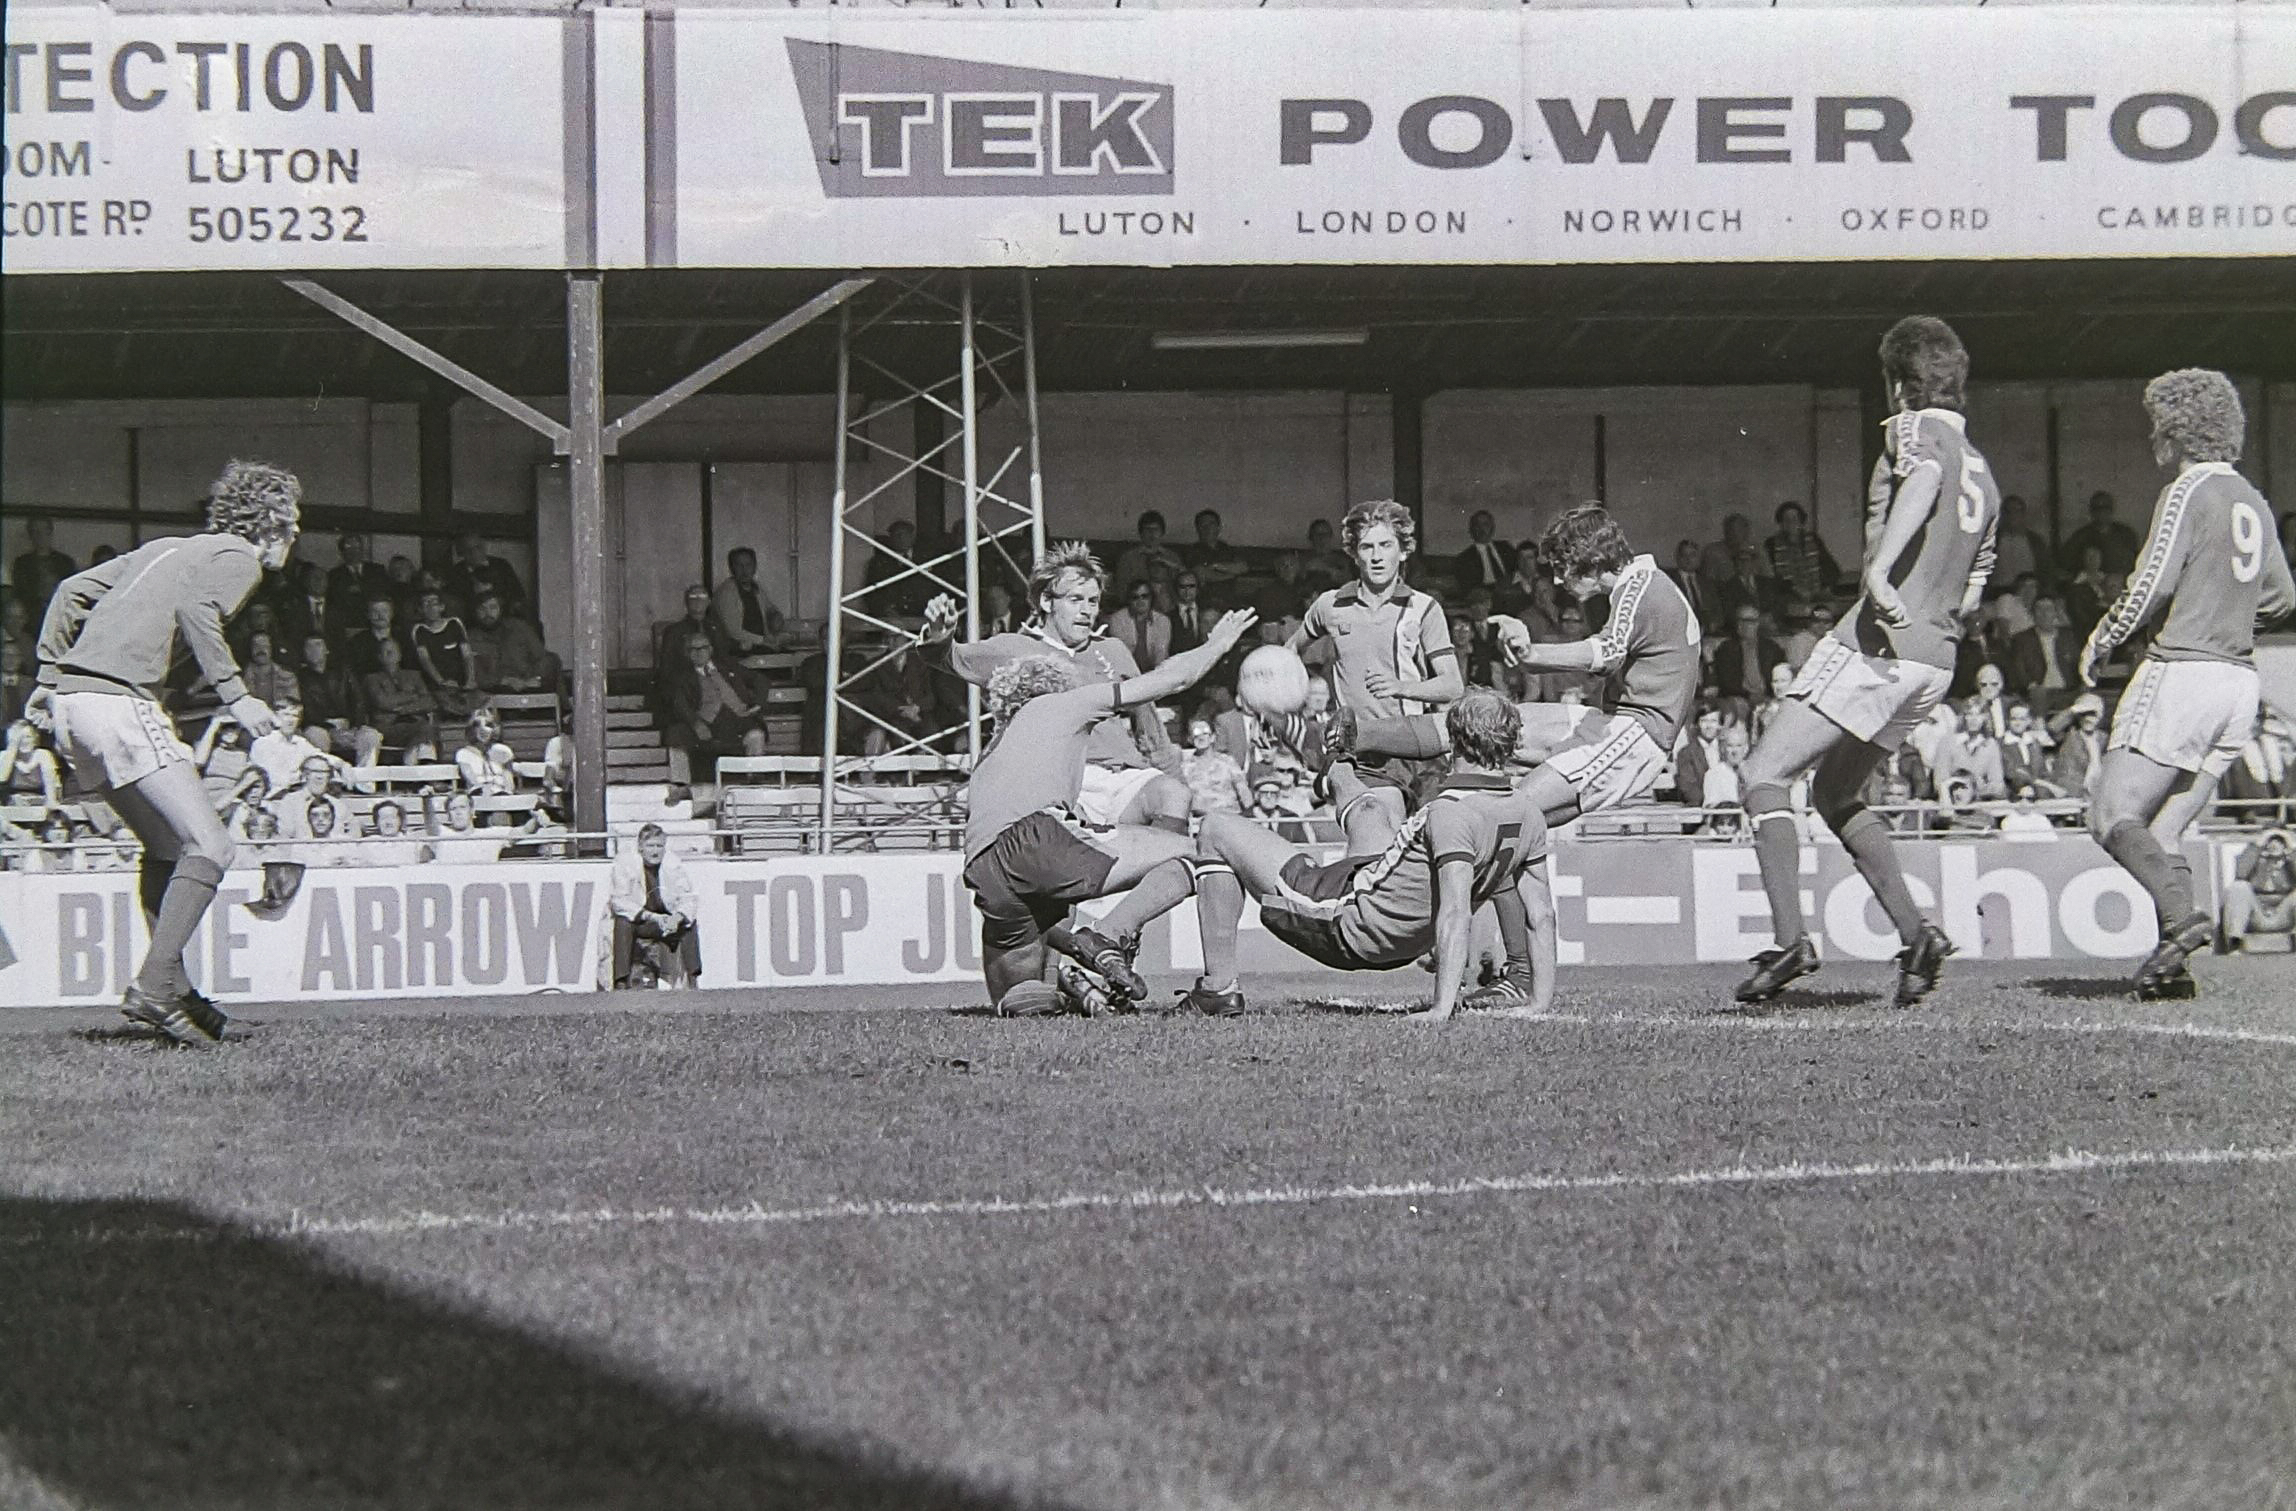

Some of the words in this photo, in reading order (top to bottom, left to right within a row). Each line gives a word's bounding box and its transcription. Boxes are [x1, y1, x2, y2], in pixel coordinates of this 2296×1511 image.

[4, 141, 91, 177] OM
[189, 148, 358, 183] LUTON
[838, 92, 1172, 177] TEK
[1280, 95, 1913, 169] POWER
[190, 206, 367, 242] 505232
[1059, 212, 1194, 235] LUTON
[1298, 211, 1465, 234] LONDON
[1565, 209, 1742, 232] NORWICH
[1841, 207, 1990, 231] OXFORD
[1957, 450, 1986, 534] 5
[2230, 502, 2264, 583] 9
[300, 880, 594, 992] ARROW
[724, 874, 870, 982] TOP
